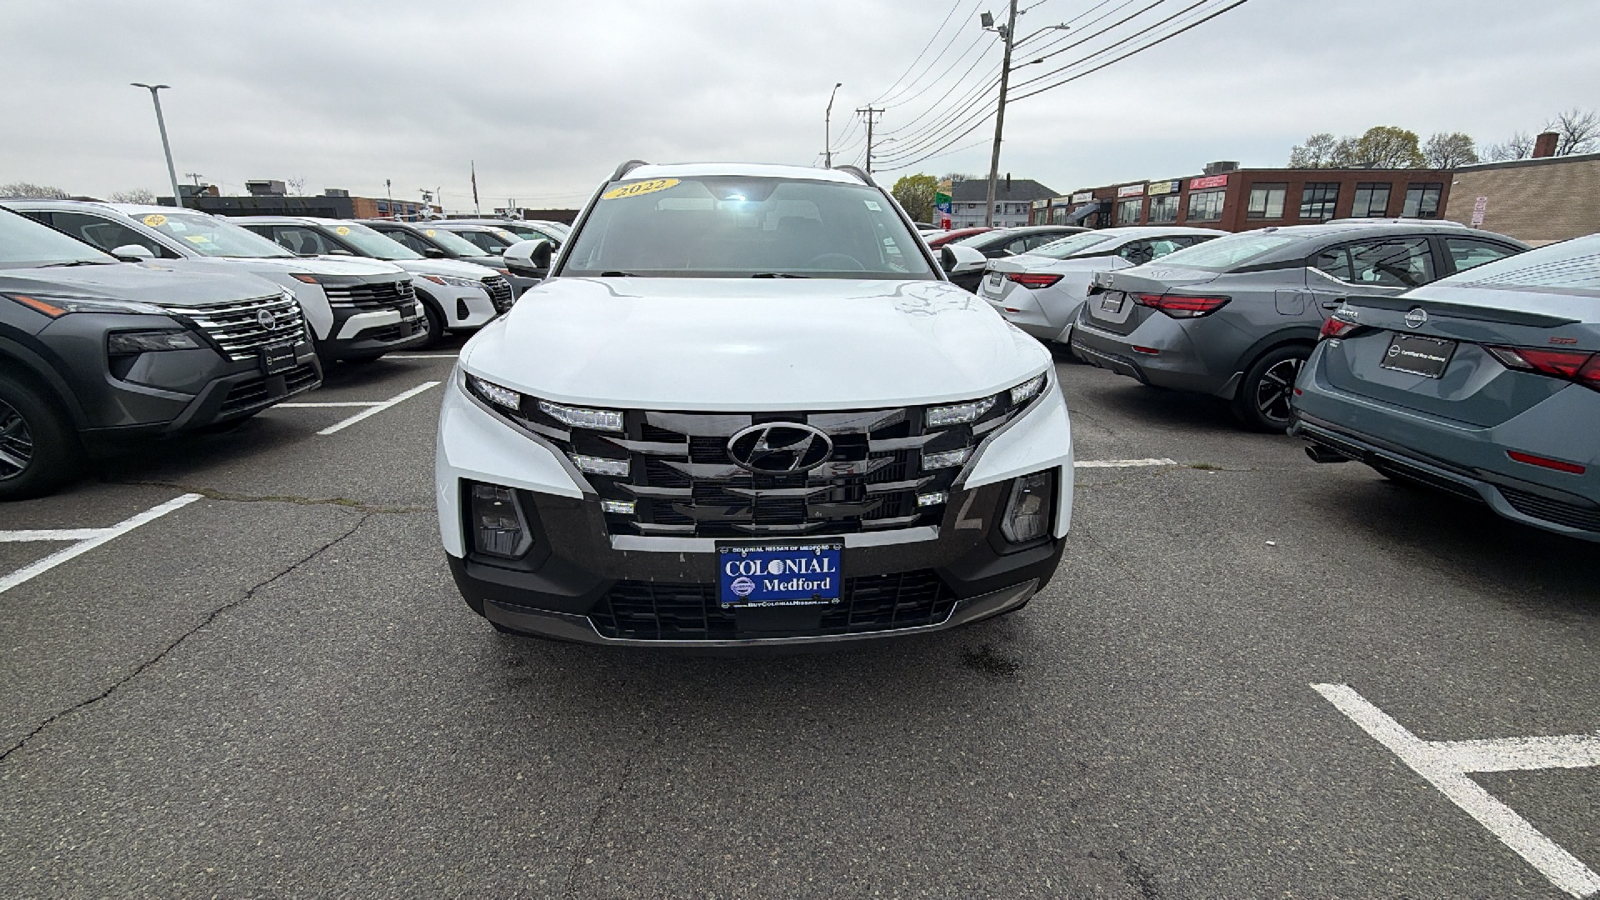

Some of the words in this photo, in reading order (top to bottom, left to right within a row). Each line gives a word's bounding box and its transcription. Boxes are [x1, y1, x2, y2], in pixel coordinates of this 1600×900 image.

[616, 180, 667, 197] 2022
[726, 558, 835, 577] COLONIAL
[763, 577, 830, 592] Medford
